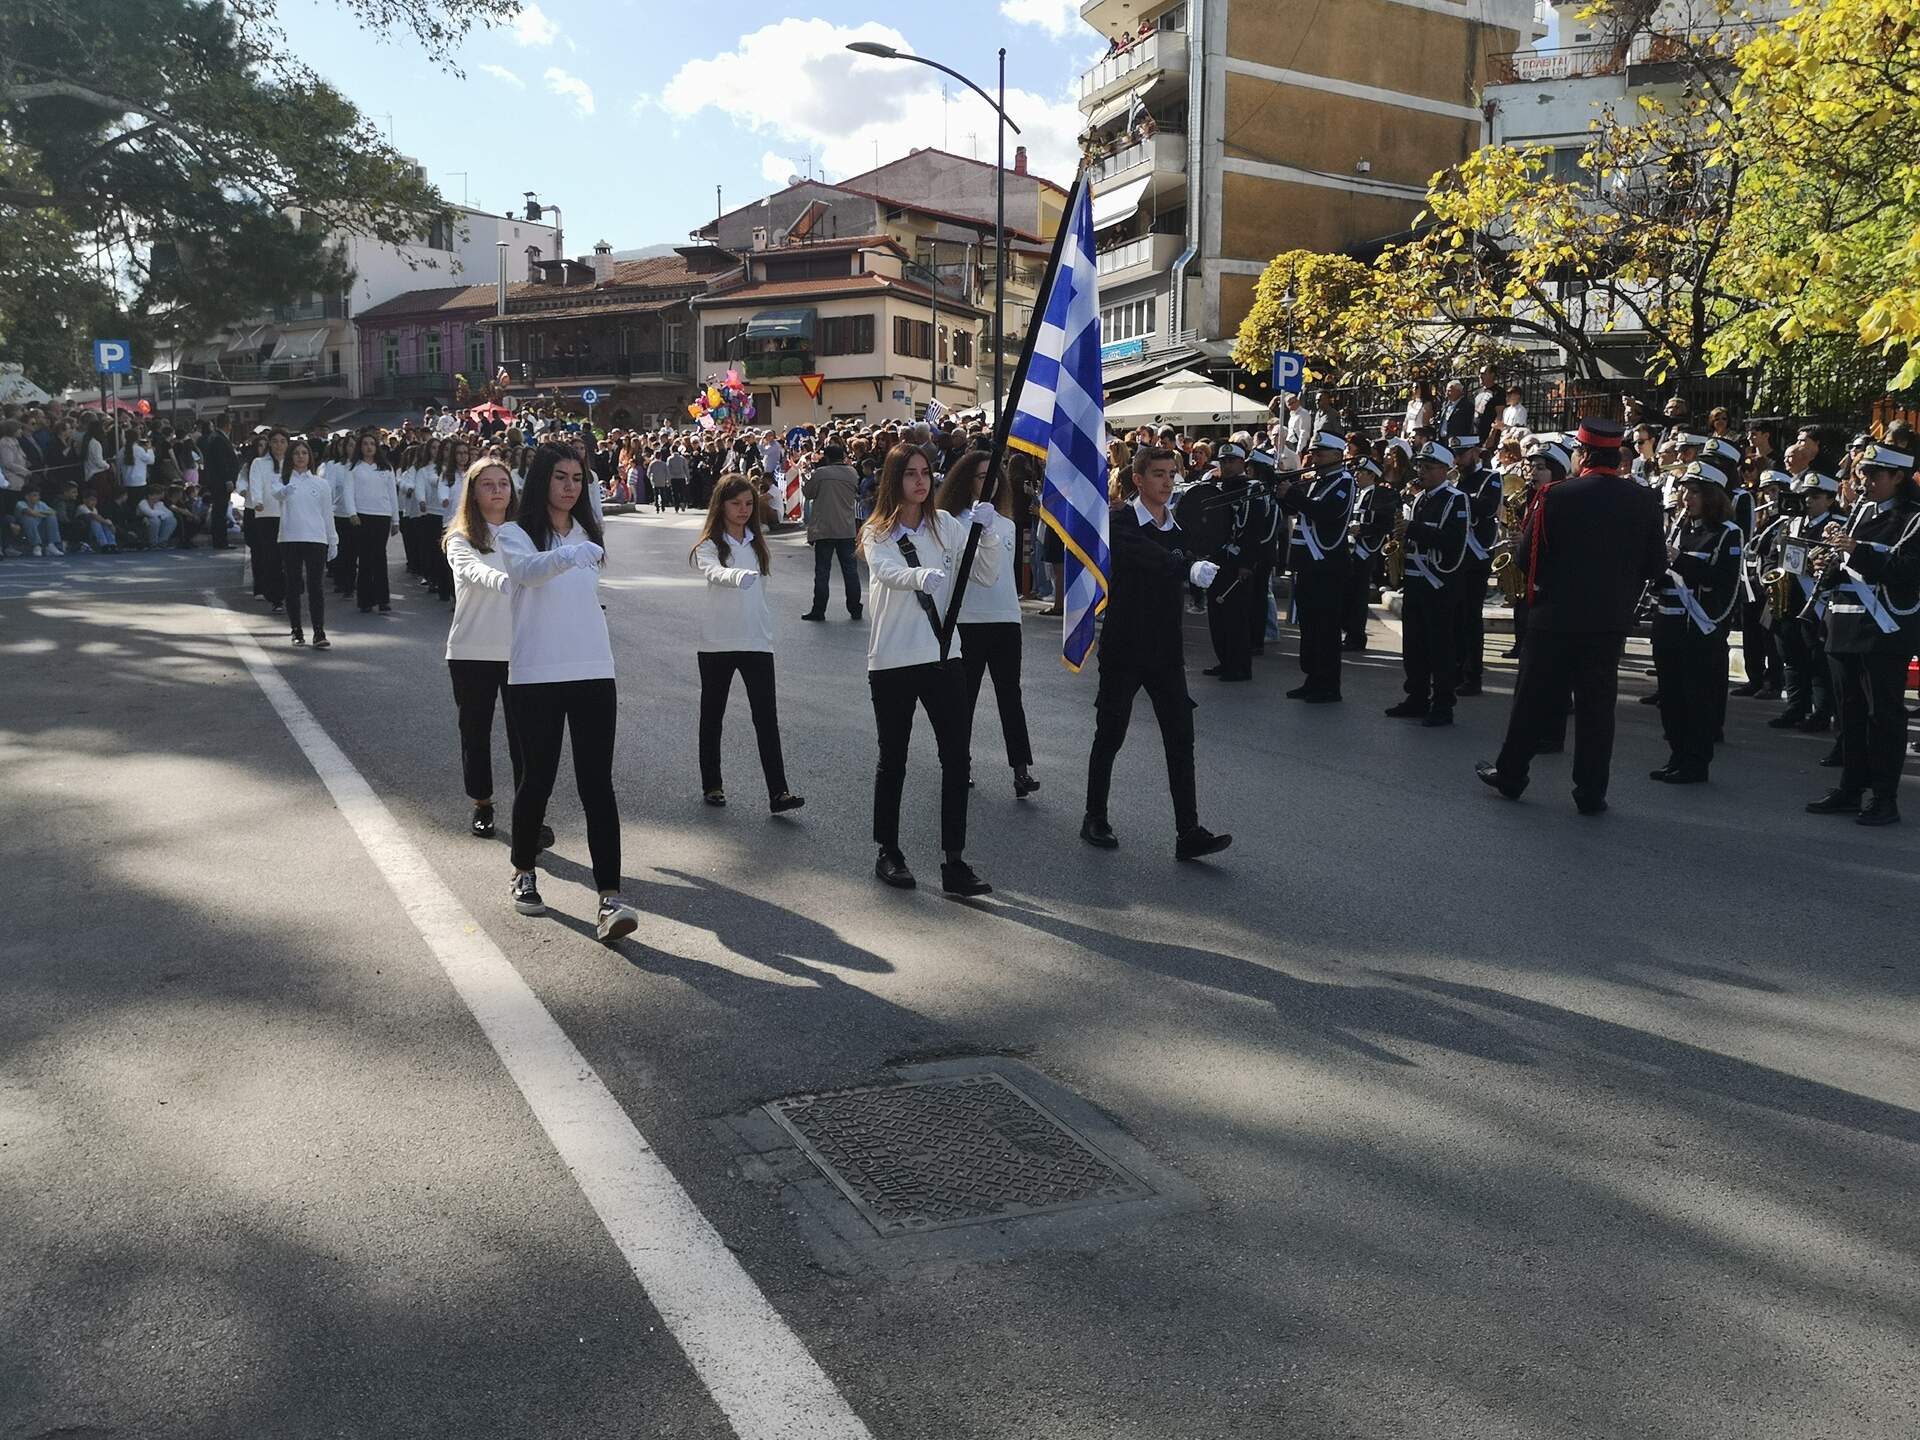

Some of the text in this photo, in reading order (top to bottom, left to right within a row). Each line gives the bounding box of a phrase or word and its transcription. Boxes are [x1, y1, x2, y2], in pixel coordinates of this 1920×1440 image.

[100, 343, 124, 369] P
[1279, 356, 1299, 387] P
[1163, 415, 1183, 423] pepsi
[856, 1159, 916, 1209] ΕΛΛΗΝΙΚΟ
